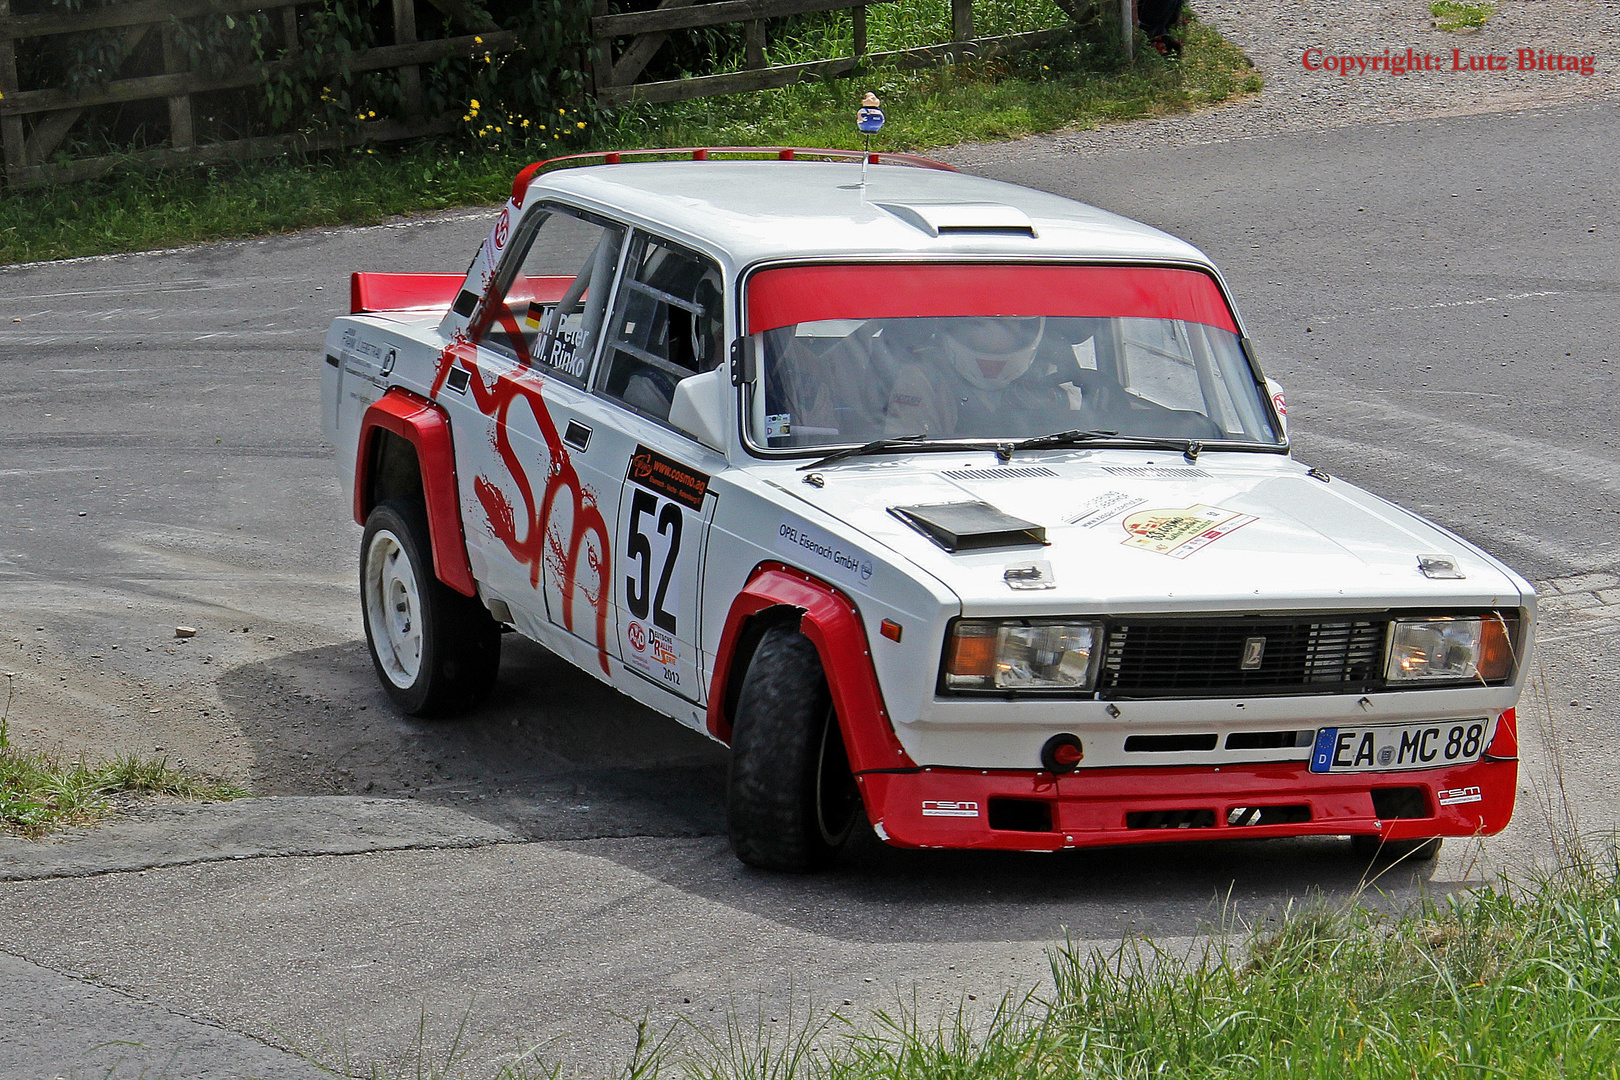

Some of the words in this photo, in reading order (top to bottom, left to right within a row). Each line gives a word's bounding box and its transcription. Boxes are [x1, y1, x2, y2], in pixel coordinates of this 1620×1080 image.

[556, 313, 590, 349] Peter
[533, 332, 547, 362] M.
[549, 339, 585, 378] Rinko
[653, 460, 706, 495] www.cosmo.ag
[626, 487, 683, 636] 52
[779, 523, 799, 544] OPEL
[800, 533, 833, 560] Eisenach
[834, 550, 860, 573] GmbH
[663, 666, 680, 686] 2012
[1318, 753, 1327, 764] D
[1332, 732, 1375, 767] EA
[1397, 728, 1440, 765] MC
[1444, 723, 1483, 760] 88
[921, 800, 979, 810] rsm
[1437, 786, 1481, 799] rsm
